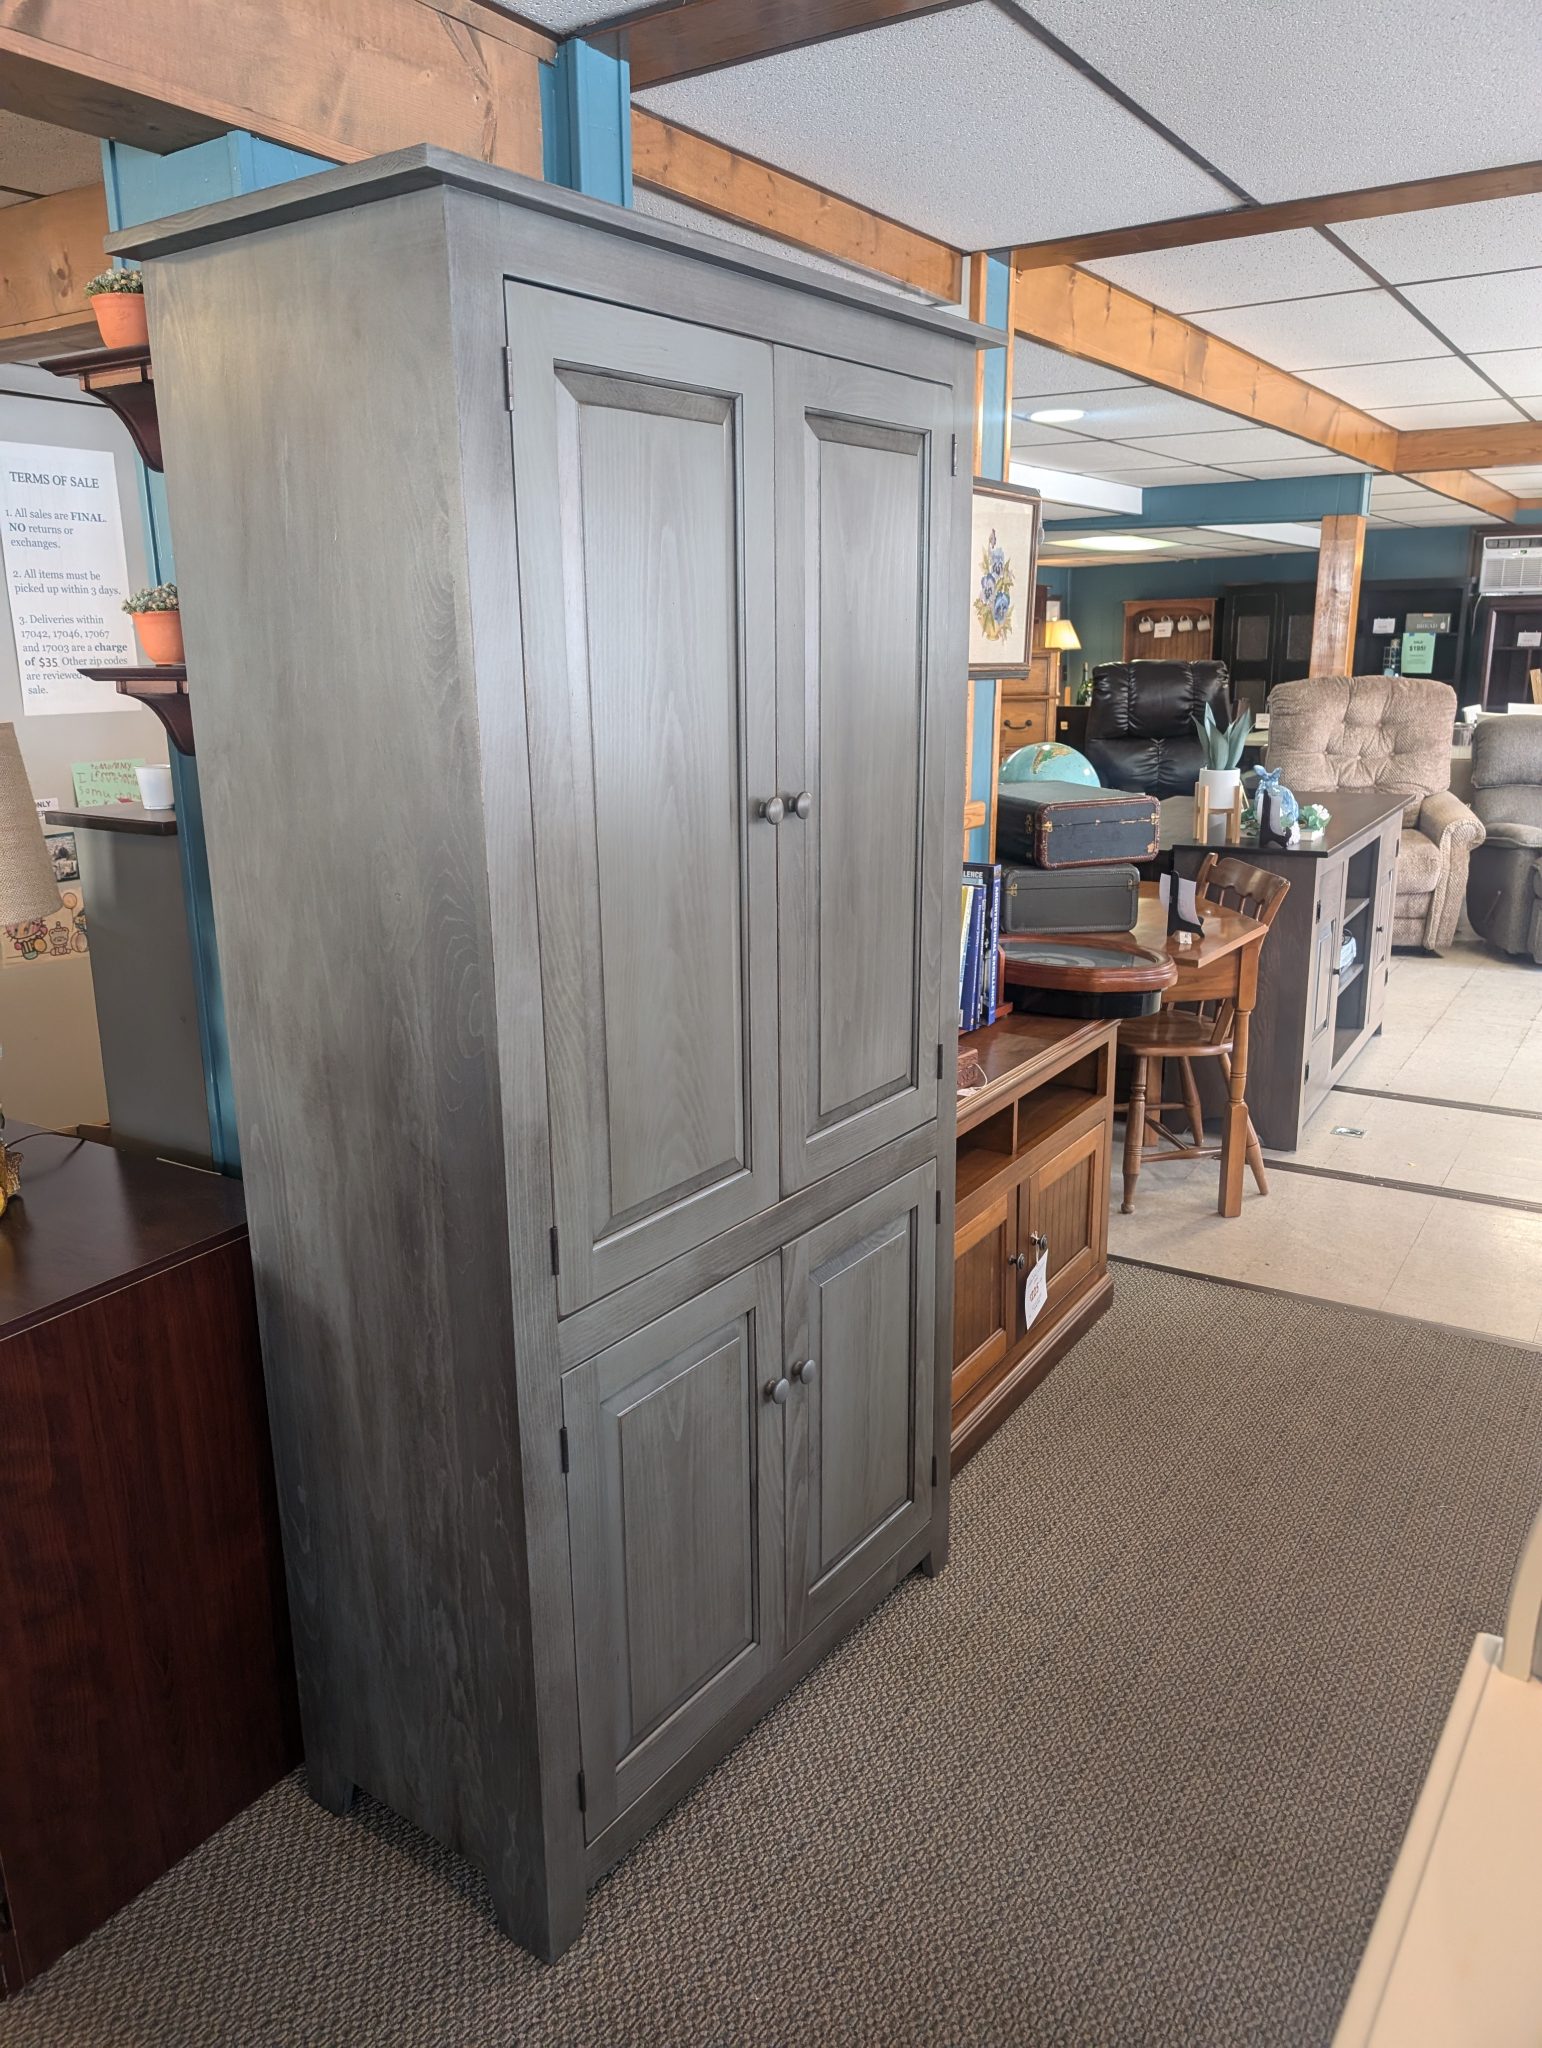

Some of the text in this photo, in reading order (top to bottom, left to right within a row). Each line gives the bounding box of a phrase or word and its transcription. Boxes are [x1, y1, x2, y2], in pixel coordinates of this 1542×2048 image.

[9, 471, 100, 489] TERMS OF SALE
[5, 508, 107, 523] 1. All sales are FINAL.
[9, 522, 74, 535] NO returns or
[10, 537, 61, 550] exchanges.
[13, 569, 101, 580] 2. All items must be
[14, 583, 121, 597] picked up within 3 days.
[29, 614, 75, 624] Deliveries
[76, 615, 104, 624] within
[21, 629, 110, 639] 17042, 17046, 17067
[23, 642, 39, 652] and
[42, 644, 70, 654] 17003
[94, 643, 128, 653] charge
[24, 656, 35, 666] of
[61, 656, 87, 666] Other
[89, 656, 102, 667] zip
[104, 656, 128, 666] codes
[28, 684, 49, 695] sale.
[36, 800, 51, 808] NLY
[963, 870, 983, 879] LENCE
